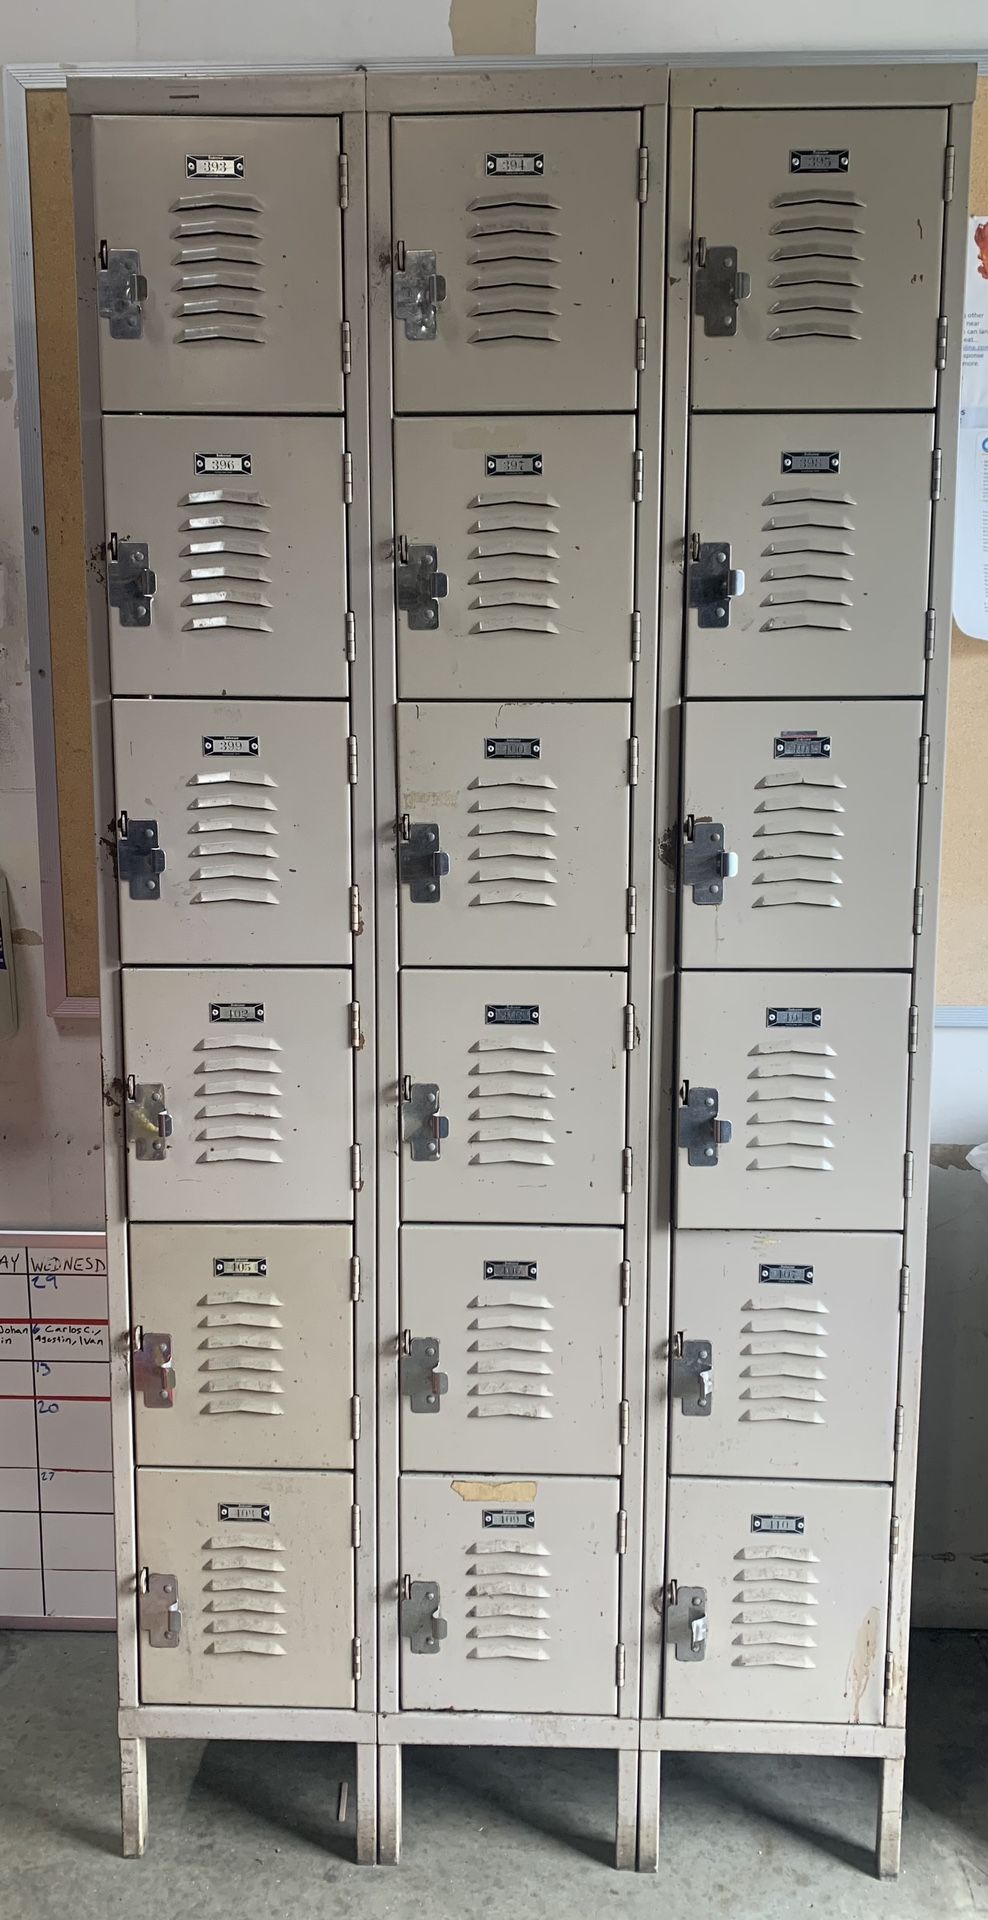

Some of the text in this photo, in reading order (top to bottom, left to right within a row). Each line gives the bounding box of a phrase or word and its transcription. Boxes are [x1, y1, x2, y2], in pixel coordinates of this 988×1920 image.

[203, 161, 227, 173] 393
[502, 159, 525, 171] 394
[212, 459, 235, 470] 396
[503, 460, 525, 471] 397
[219, 740, 243, 751] 399
[31, 1274, 58, 1289] 29
[79, 1335, 104, 1346] Ivan
[37, 1400, 59, 1414] 20
[41, 1471, 55, 1481] 27
